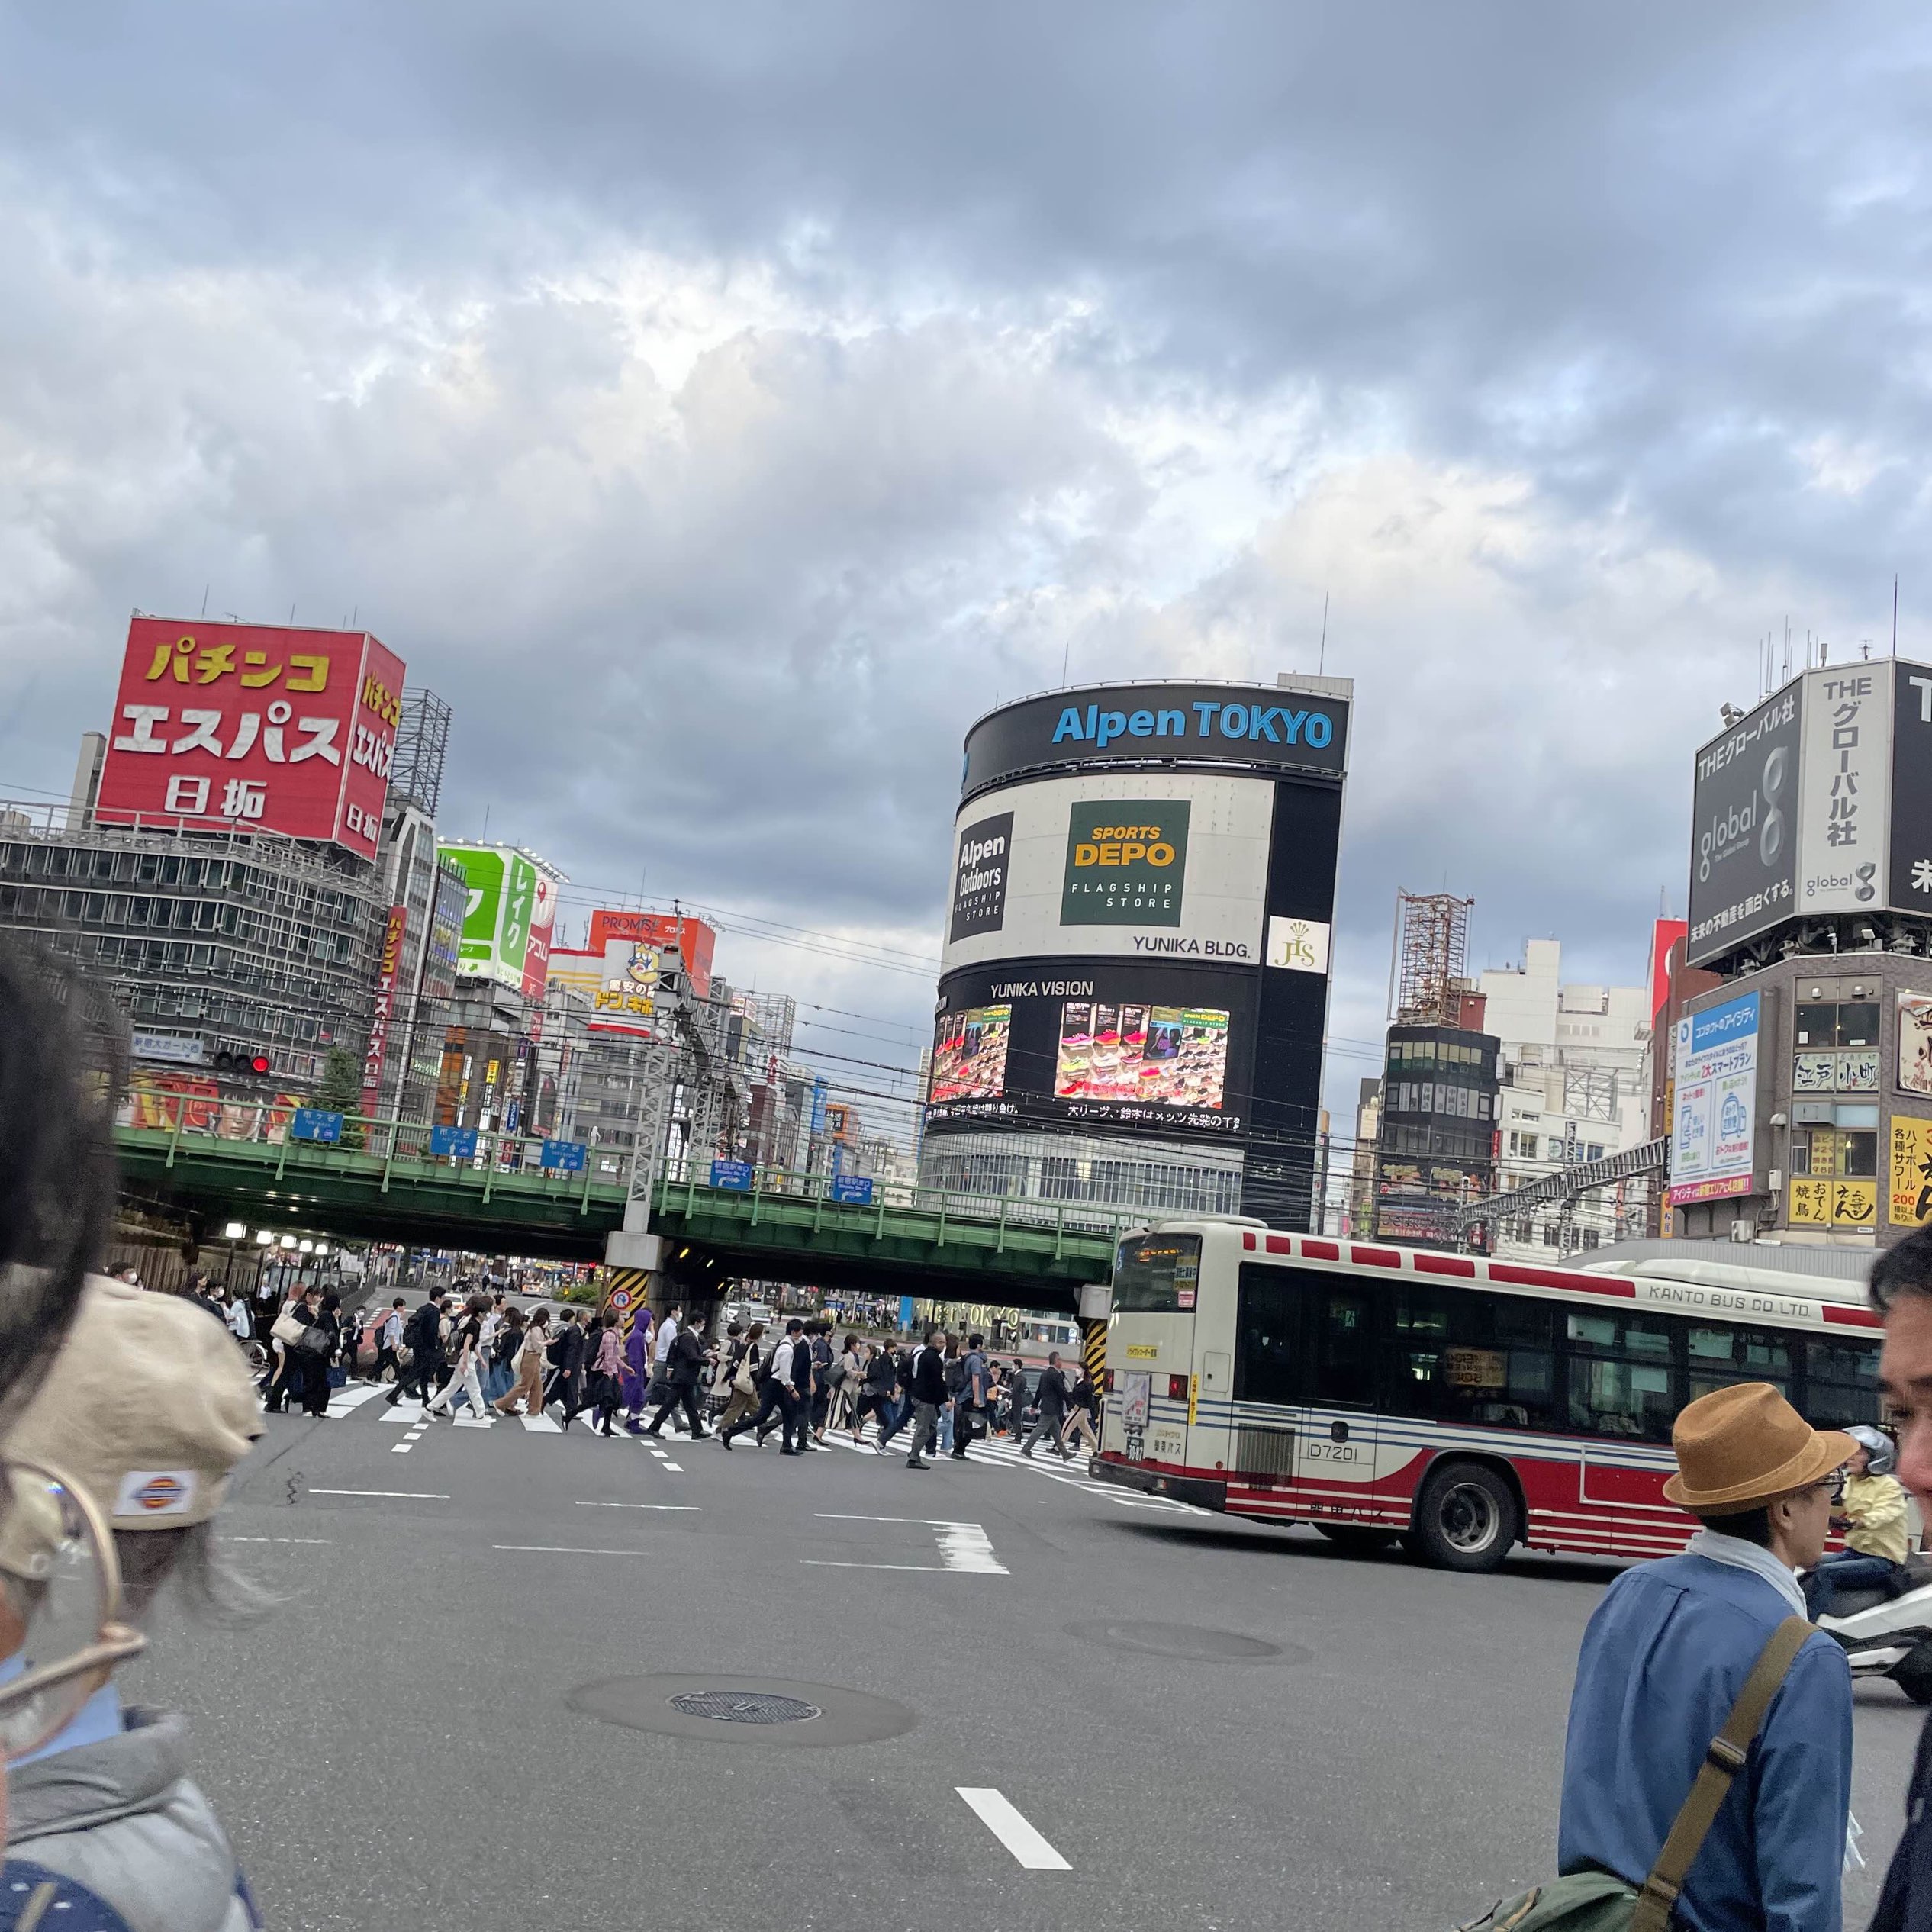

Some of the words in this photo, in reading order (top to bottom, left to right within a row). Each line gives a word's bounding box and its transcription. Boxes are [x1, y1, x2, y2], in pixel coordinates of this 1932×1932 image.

[145, 635, 330, 691] パチンコ
[362, 671, 400, 726] パチンコ
[1824, 677, 1872, 700] THE
[113, 700, 340, 766] エスパス
[1051, 704, 1186, 747] Alpen
[1193, 701, 1333, 749] TOKYO
[1698, 694, 1795, 782] THEグローバル社
[353, 723, 394, 778] エスパス
[1827, 701, 1862, 847] グローバル社
[164, 774, 267, 819] 日拓
[346, 803, 378, 842] 日拓
[1091, 825, 1161, 840] SPORTS
[1699, 790, 1757, 882] global
[960, 836, 1005, 868] Alpen
[1074, 841, 1175, 866] DEPO
[960, 868, 1001, 897] Outdoors
[1071, 883, 1173, 894] FLAGSHIP
[1807, 873, 1853, 897] global
[508, 864, 527, 949] レイク
[955, 891, 1000, 913] FLAGSHIP
[966, 905, 999, 921] STORE
[1106, 897, 1171, 909] STORE
[528, 935, 548, 962] アコム
[1132, 935, 1199, 955] YUNIKA
[1204, 939, 1251, 959] BLDG.
[990, 981, 1038, 999] YUNIKA
[1042, 980, 1094, 997] VISION
[1201, 1013, 1226, 1022] DEPO
[1894, 1128, 1905, 1190] 各種サワー
[1905, 1130, 1917, 1190] ハイボール
[1795, 1185, 1810, 1217] 焼鳥
[1814, 1182, 1825, 1221] おでん
[1893, 1194, 1915, 1206] 200
[1649, 1286, 1705, 1304] KANTO
[1711, 1294, 1746, 1309] BUS
[1310, 1444, 1357, 1462] D7201
